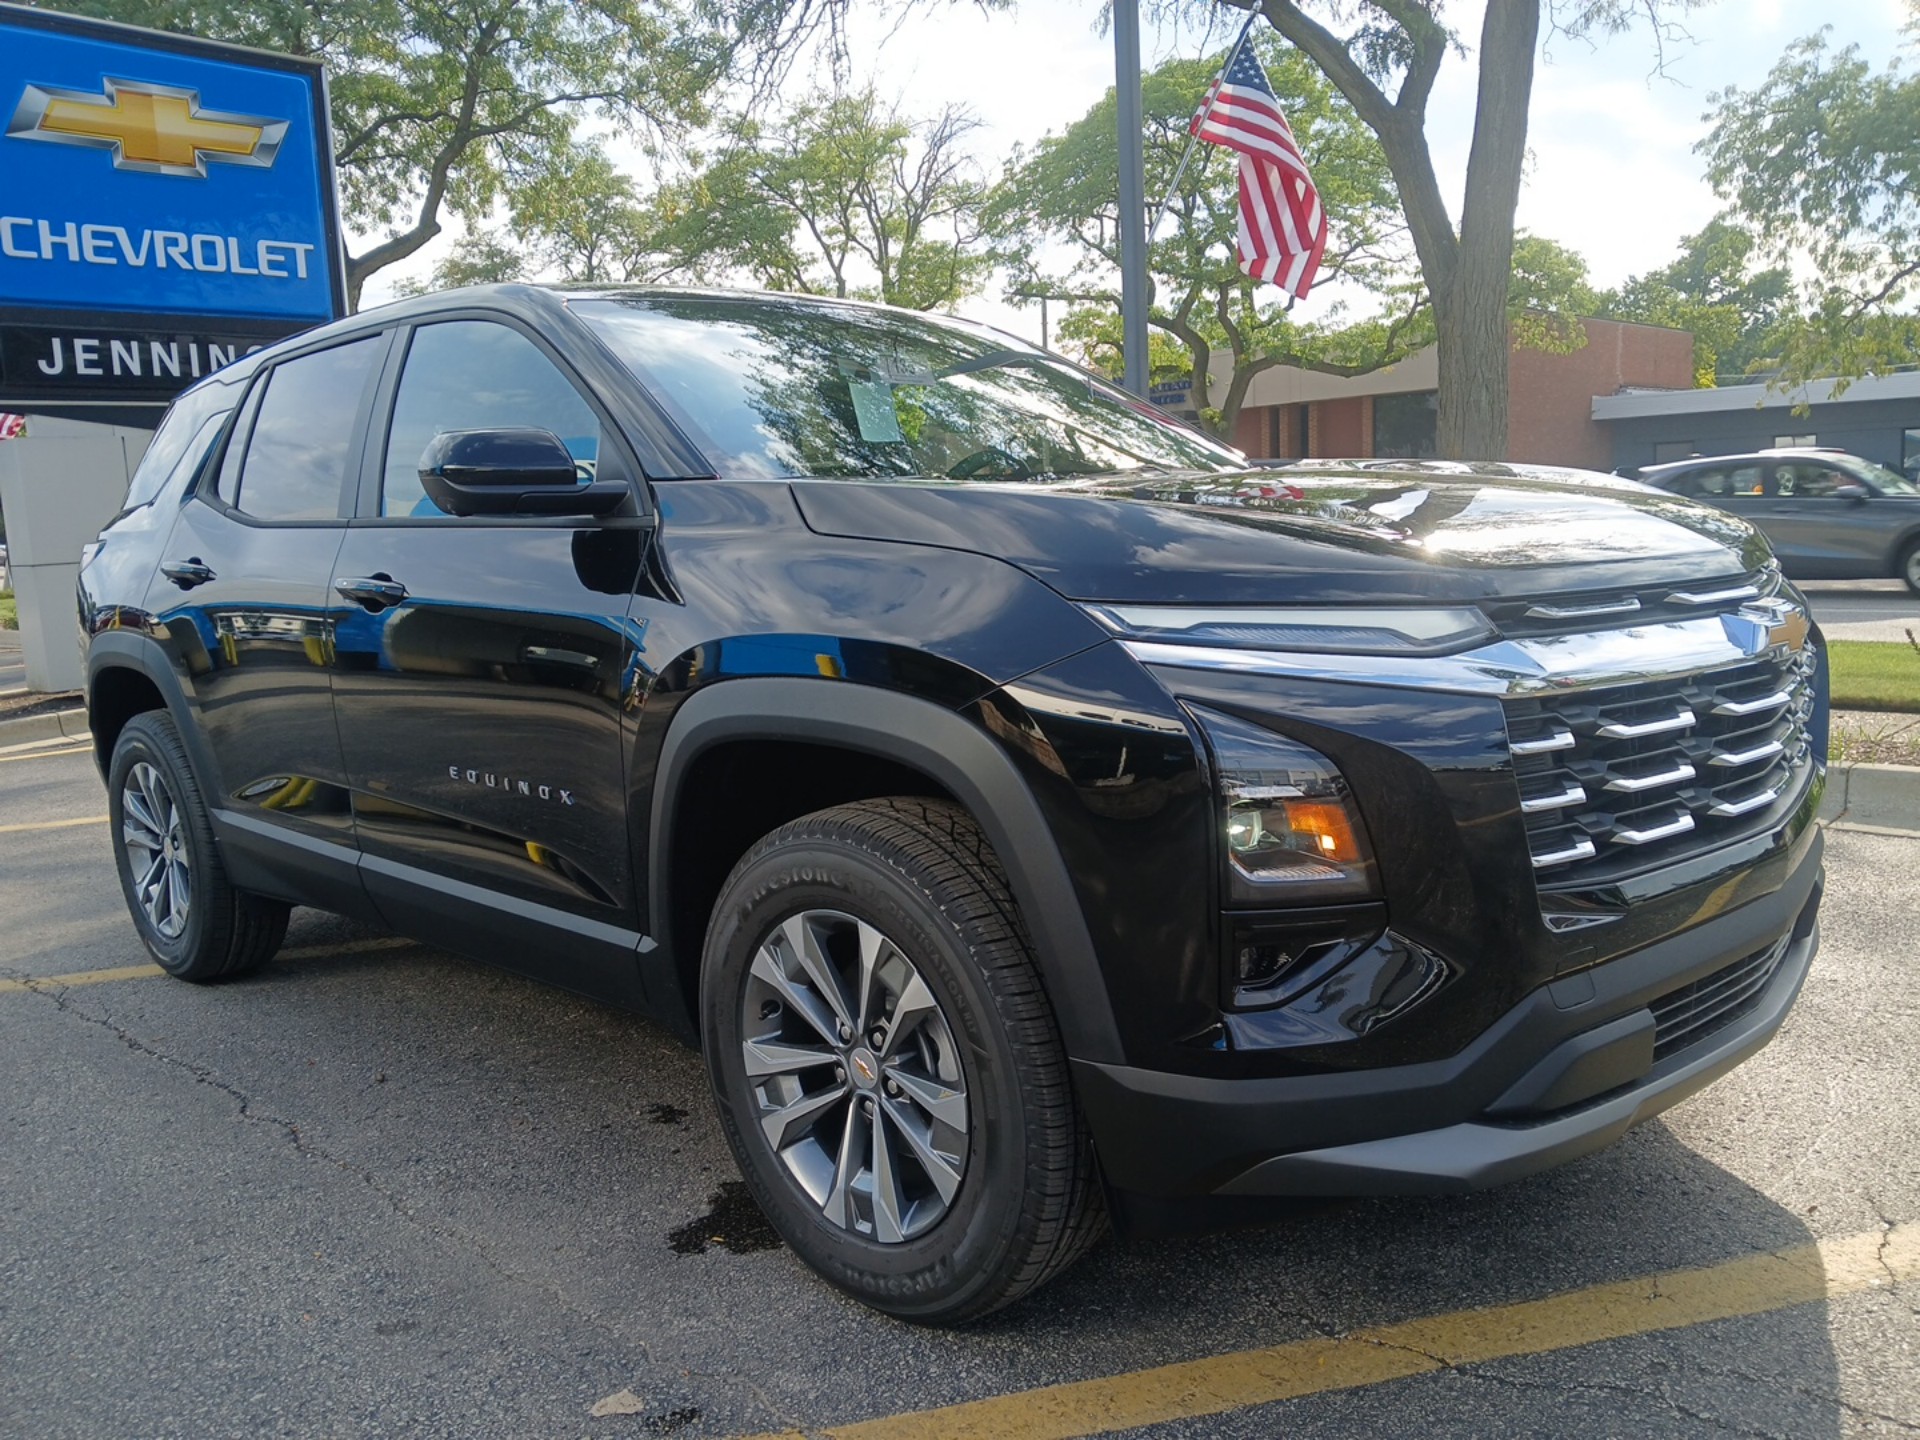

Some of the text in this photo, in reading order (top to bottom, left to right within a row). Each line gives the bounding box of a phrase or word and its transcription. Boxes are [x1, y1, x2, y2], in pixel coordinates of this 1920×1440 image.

[1, 216, 314, 278] CHEVROLET
[37, 337, 265, 377] JENNIN
[449, 766, 573, 805] EQUINOX
